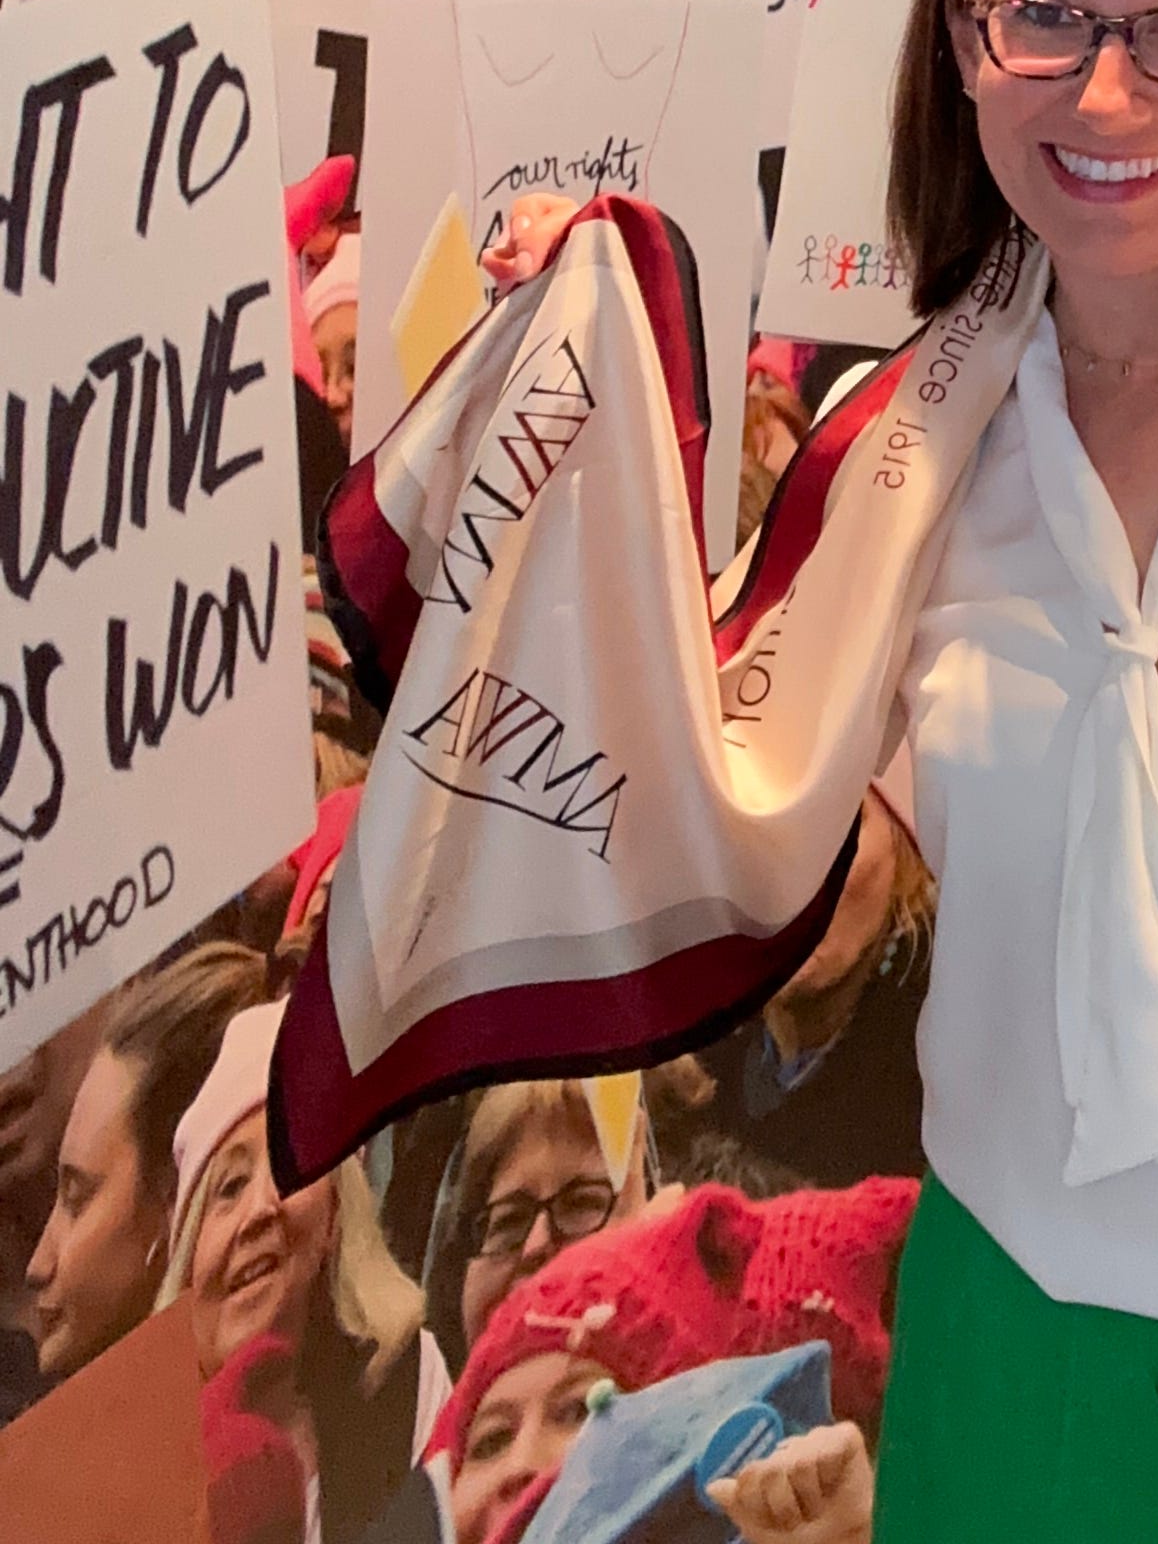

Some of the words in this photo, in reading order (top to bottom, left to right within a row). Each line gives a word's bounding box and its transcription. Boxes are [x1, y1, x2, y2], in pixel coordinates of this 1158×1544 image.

[136, 22, 251, 239] TO
[105, 540, 280, 772] WON
[0, 845, 175, 1018] NTHOOD
